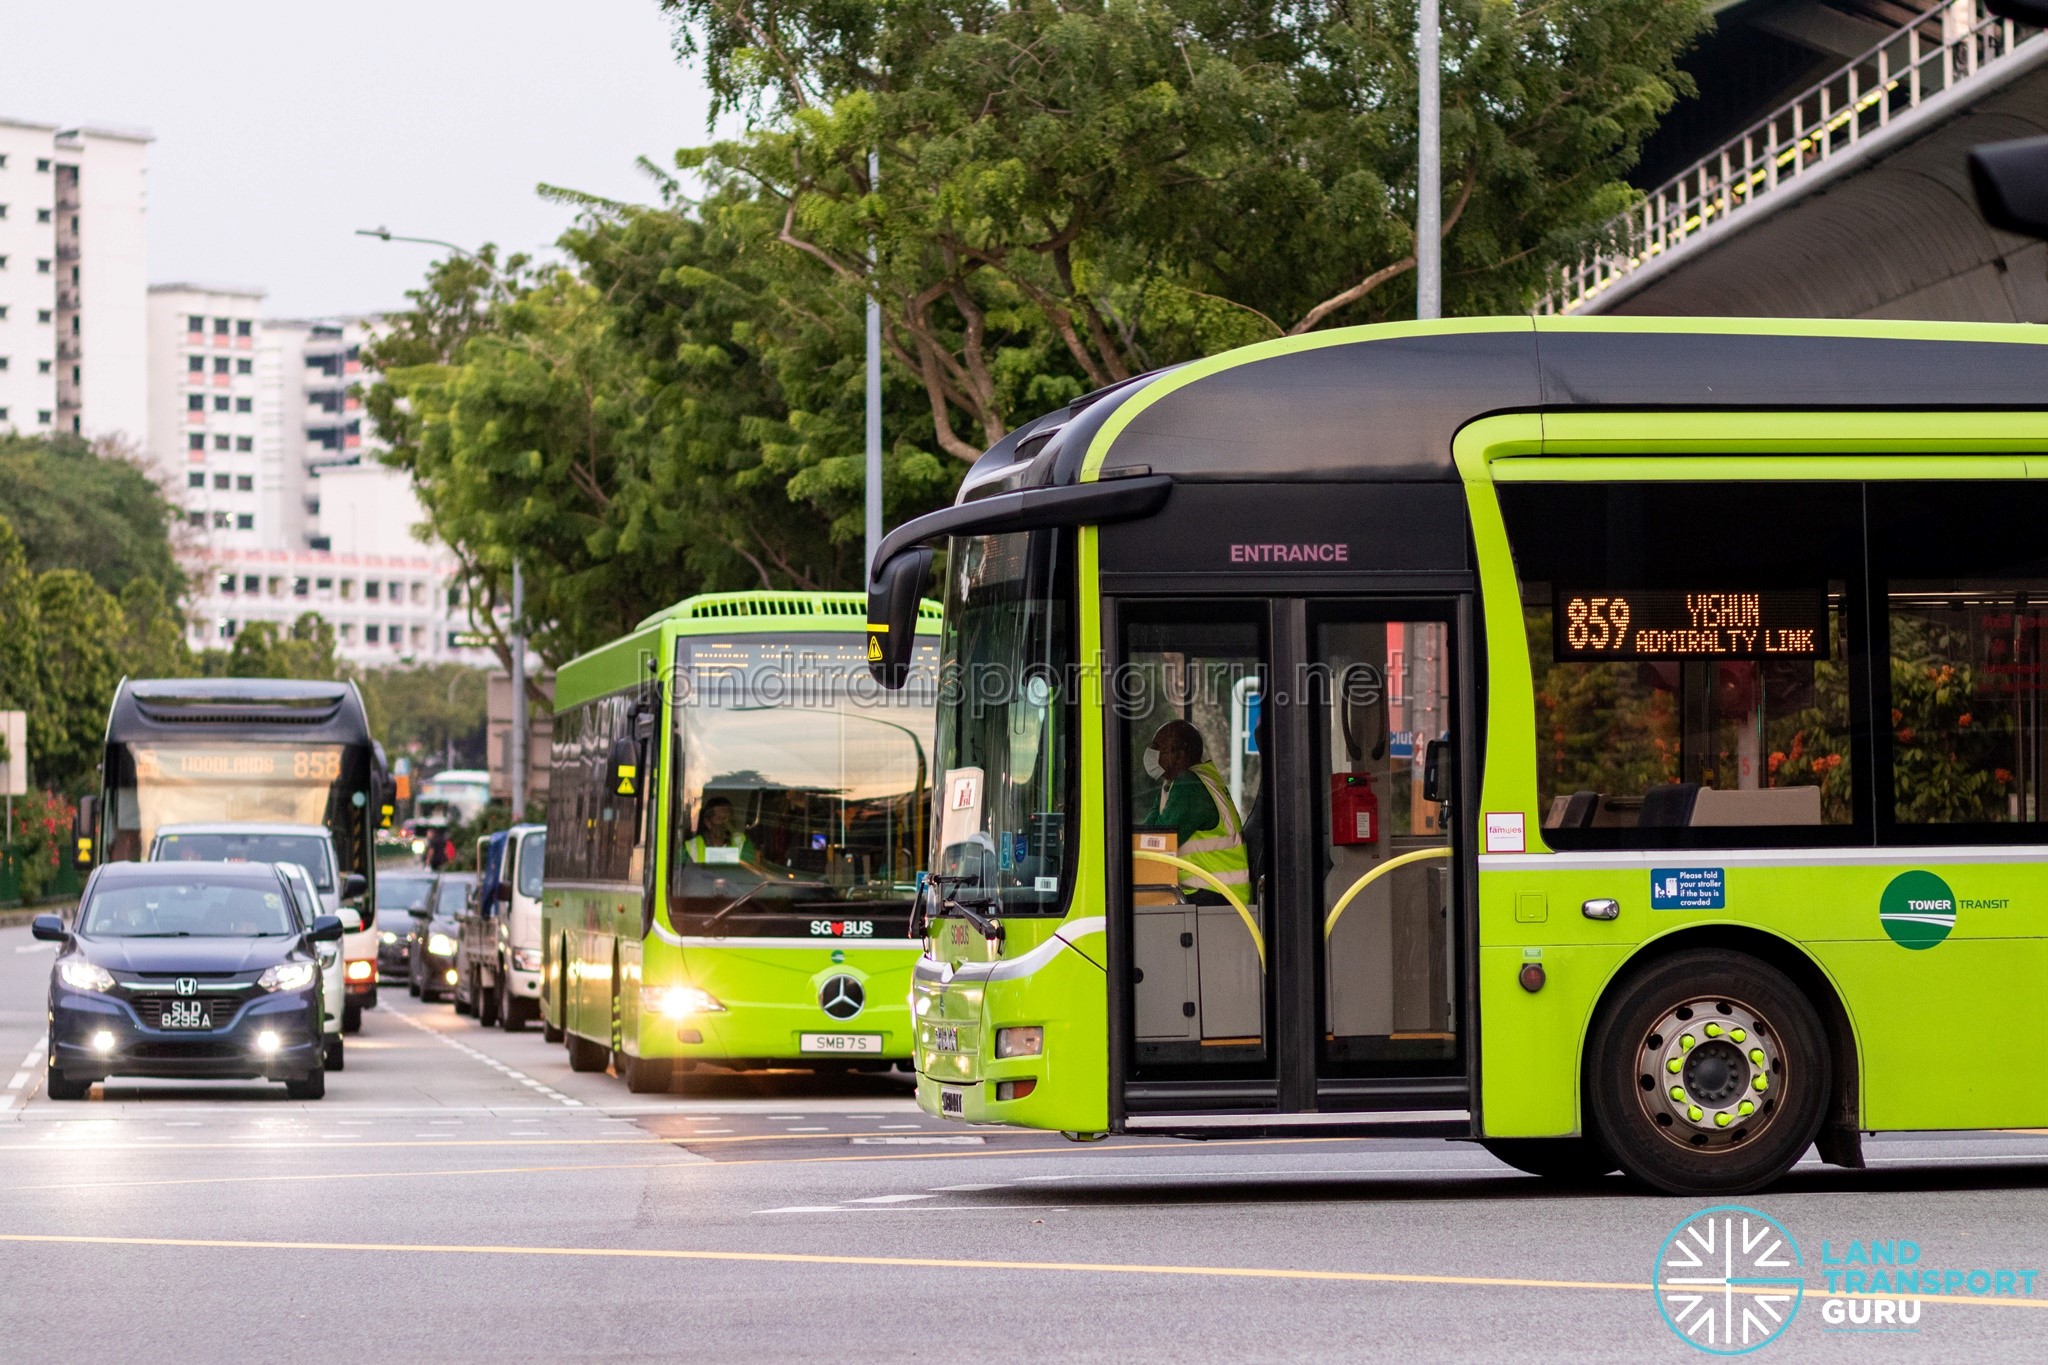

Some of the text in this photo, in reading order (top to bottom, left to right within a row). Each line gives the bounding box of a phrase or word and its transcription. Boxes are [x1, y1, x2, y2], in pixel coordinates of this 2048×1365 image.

[1230, 544, 1348, 562] ENTRANCE
[1687, 594, 1759, 627] YISHUN
[1567, 598, 1630, 650] 859
[1636, 629, 1814, 652] ADMIRALTY LINK
[294, 751, 341, 779] 858
[1704, 871, 1718, 879] fold
[1698, 880, 1722, 888] stroller
[1680, 898, 1711, 906] crowded
[1908, 899, 2010, 910] TOWER TRANSIT
[172, 1001, 202, 1014] SLD
